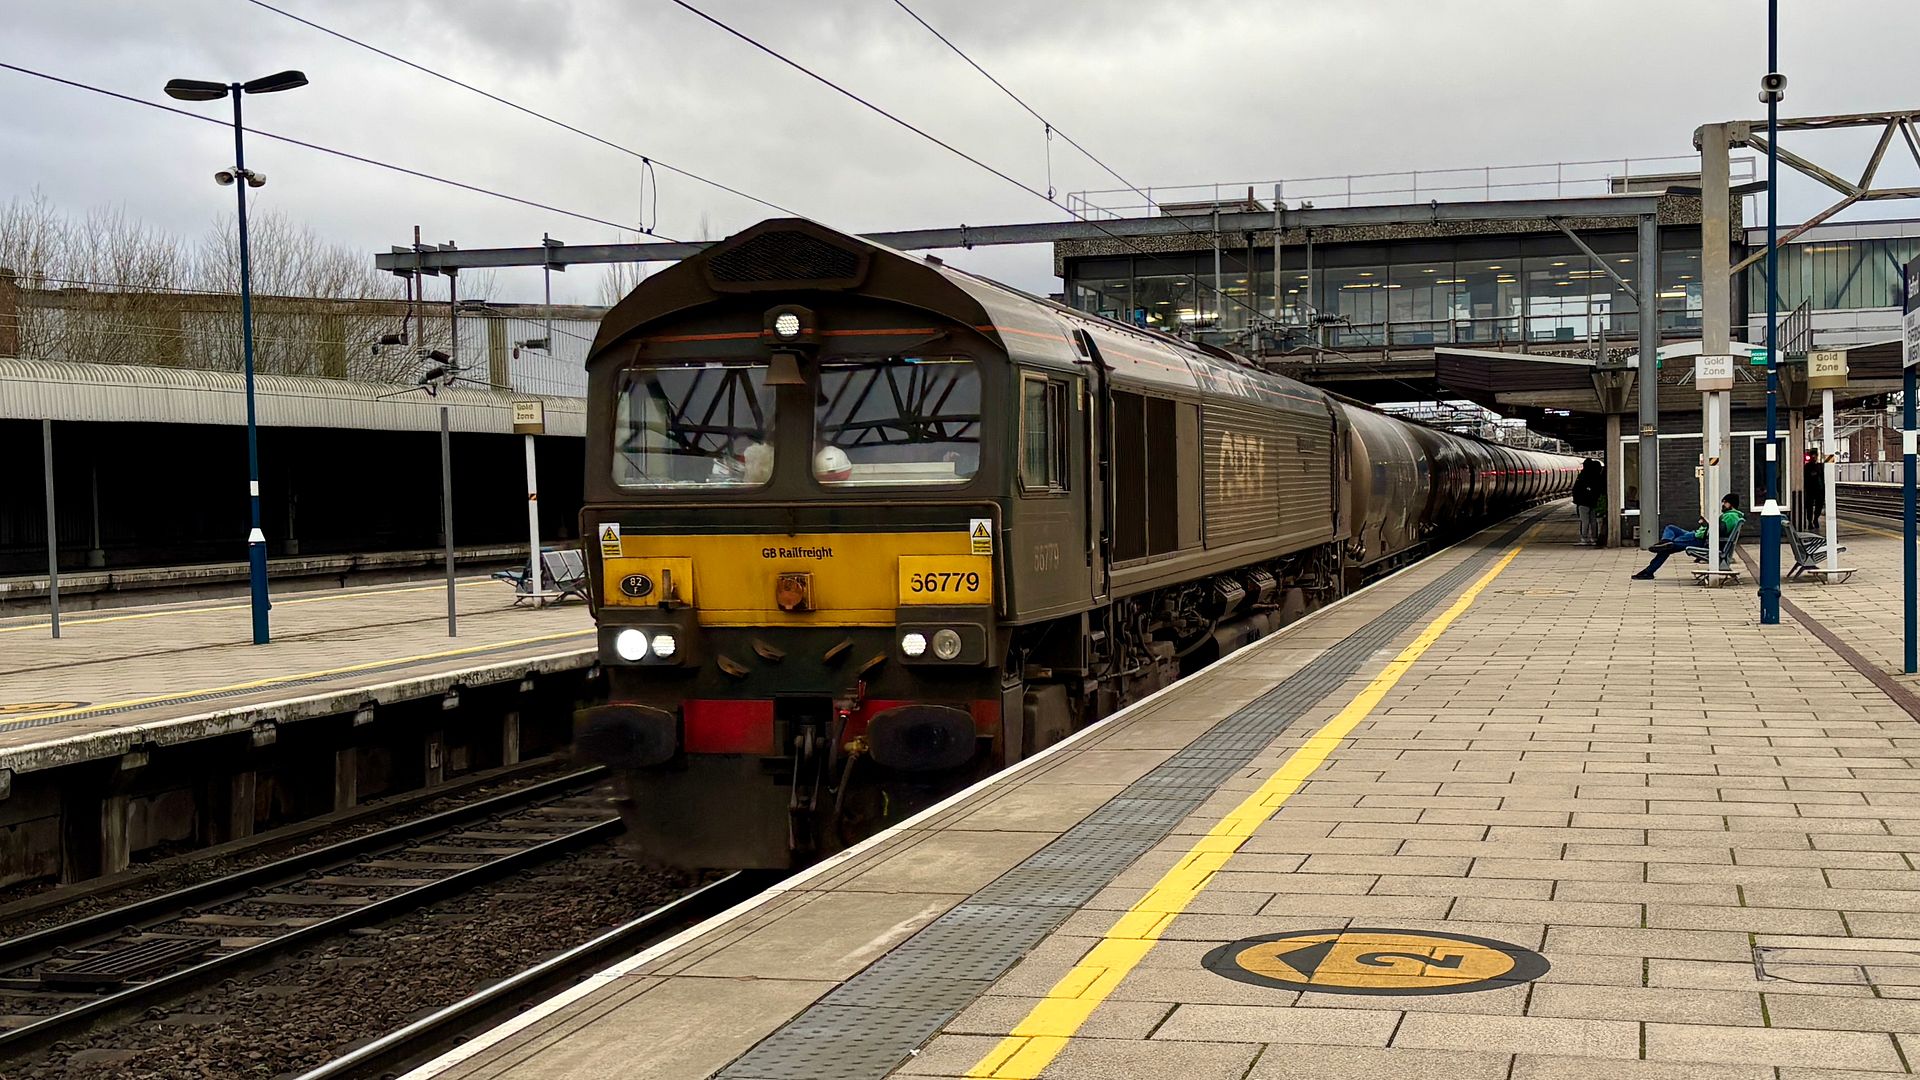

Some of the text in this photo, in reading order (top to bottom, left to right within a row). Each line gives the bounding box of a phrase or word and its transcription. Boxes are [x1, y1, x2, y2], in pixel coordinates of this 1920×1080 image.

[1816, 353, 1838, 361] Gold
[1704, 357, 1725, 366] Gold
[1703, 368, 1725, 376] Zone
[1815, 364, 1839, 372] Zone
[516, 403, 534, 411] Gold
[762, 546, 834, 560] GB Railfreight
[630, 577, 643, 587] 82
